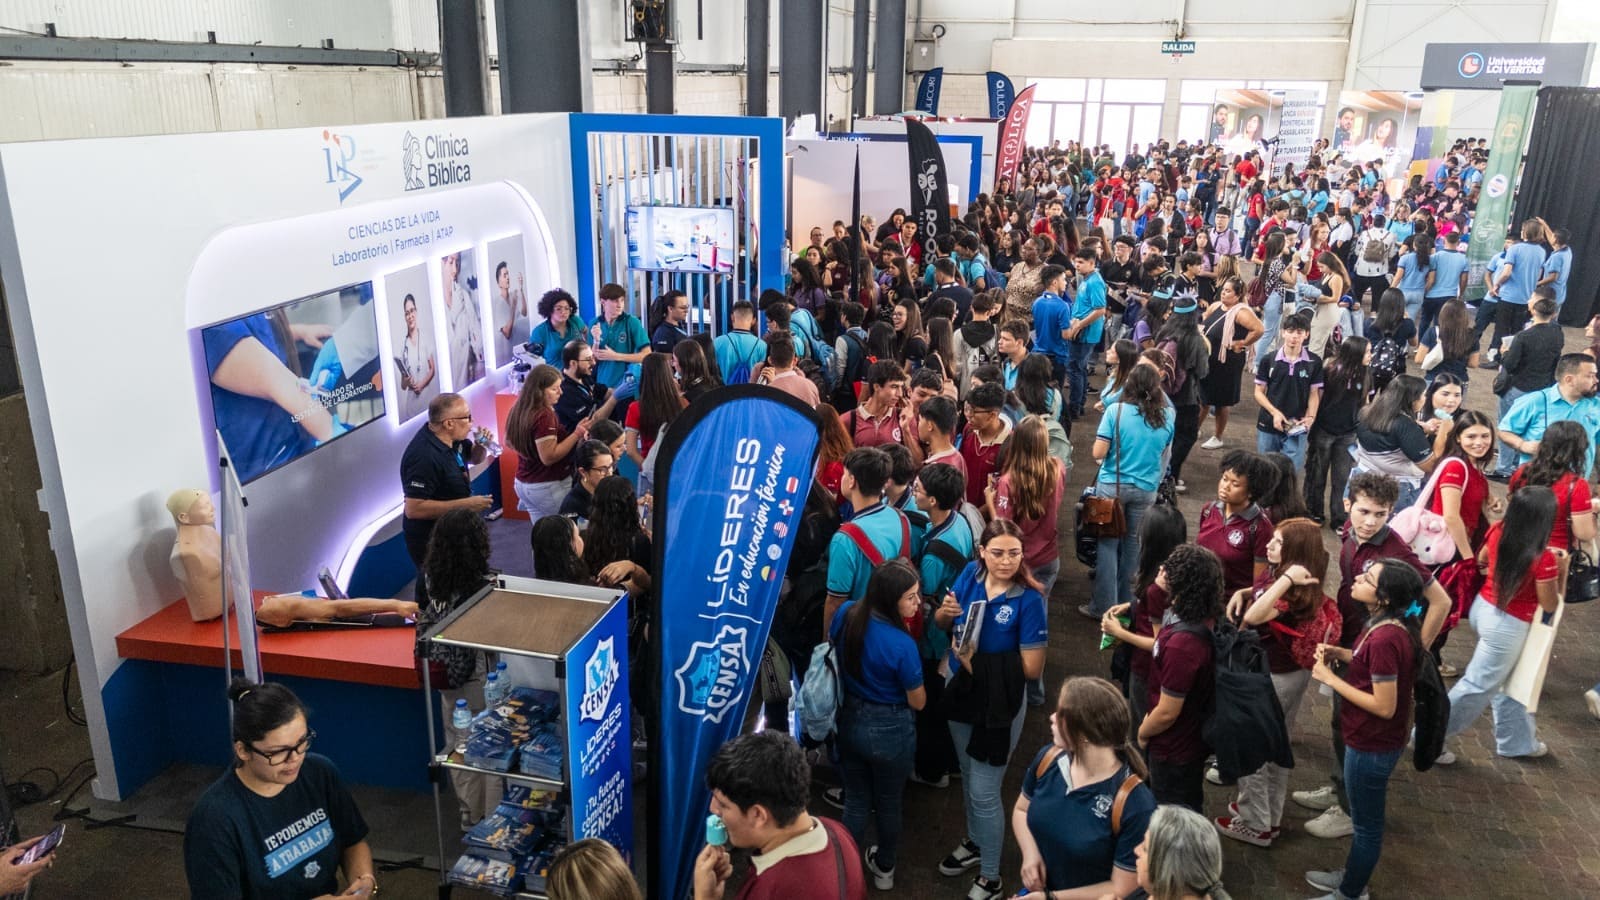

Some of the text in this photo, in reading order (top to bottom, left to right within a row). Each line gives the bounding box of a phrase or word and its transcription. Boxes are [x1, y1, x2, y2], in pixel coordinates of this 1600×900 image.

[1162, 43, 1194, 51] SALIDA
[1487, 56, 1546, 66] Universidad
[1486, 65, 1545, 74] LCI VERITAS
[348, 210, 440, 240] CIENCIAS DE LA VIDA
[332, 242, 389, 266] Laboratorio
[395, 233, 430, 251] Farmacia
[436, 226, 454, 241] ATAP
[332, 382, 373, 406] LABORATORIO
[707, 438, 761, 607] LÍDERES
[738, 502, 770, 579] educación
[729, 580, 750, 606] En
[585, 669, 615, 715] CENSA
[706, 642, 741, 708] CENSA
[598, 770, 621, 801] futuro
[581, 778, 625, 833] comienza en
[583, 792, 623, 840] CENSA!
[264, 808, 327, 851] TE PONEMOS
[271, 857, 282, 872] A
